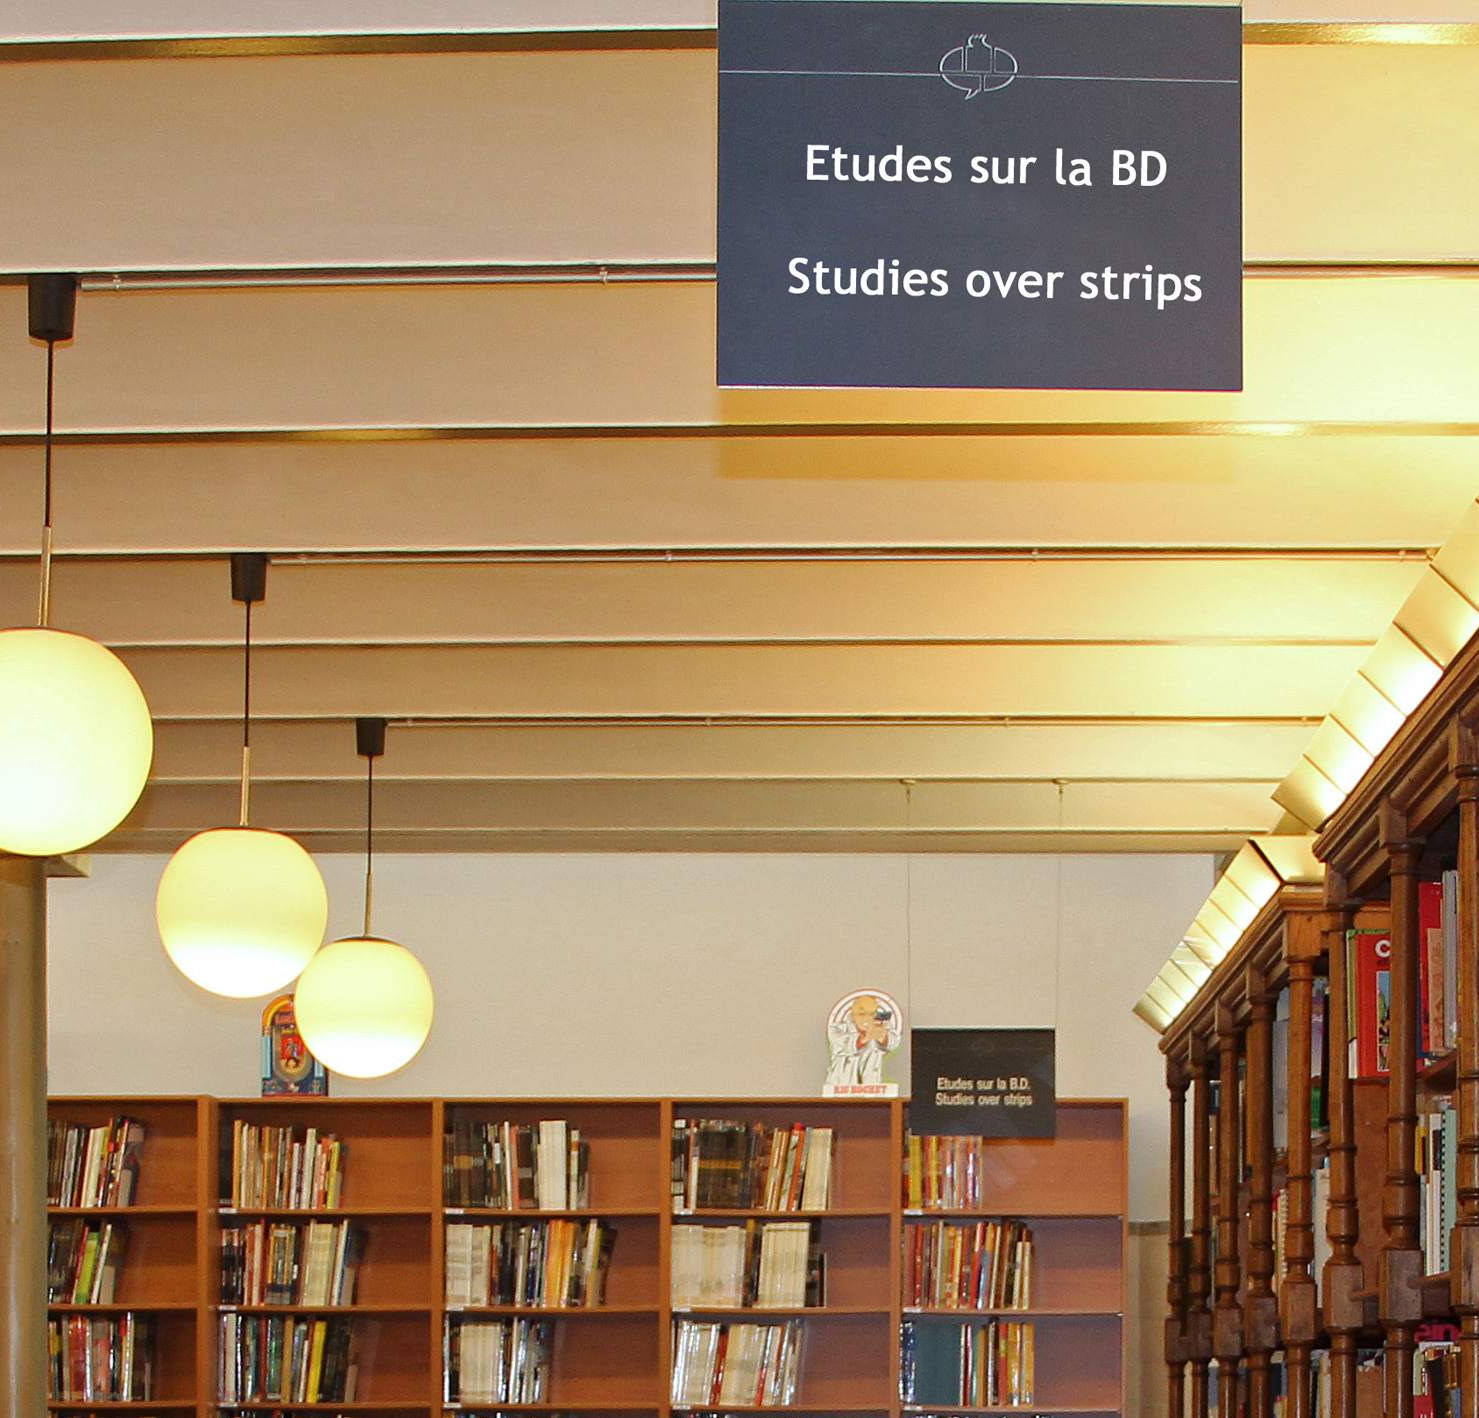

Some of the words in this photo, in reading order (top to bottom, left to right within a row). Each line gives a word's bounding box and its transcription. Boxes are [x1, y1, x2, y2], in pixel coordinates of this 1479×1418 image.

[806, 144, 952, 184] Etudes
[969, 152, 1037, 185] sur
[1055, 148, 1093, 187] la
[1112, 150, 1168, 187] BD
[788, 257, 949, 296] Studies
[965, 268, 1065, 299] over
[1080, 265, 1203, 310] strips
[937, 1077, 974, 1091] Etudes
[976, 1079, 994, 1091] sur
[996, 1078, 1007, 1090] la
[1009, 1077, 1031, 1091] B.D.
[935, 1092, 975, 1106] Studies
[977, 1095, 1001, 1106] over
[1003, 1093, 1033, 1107] strips
